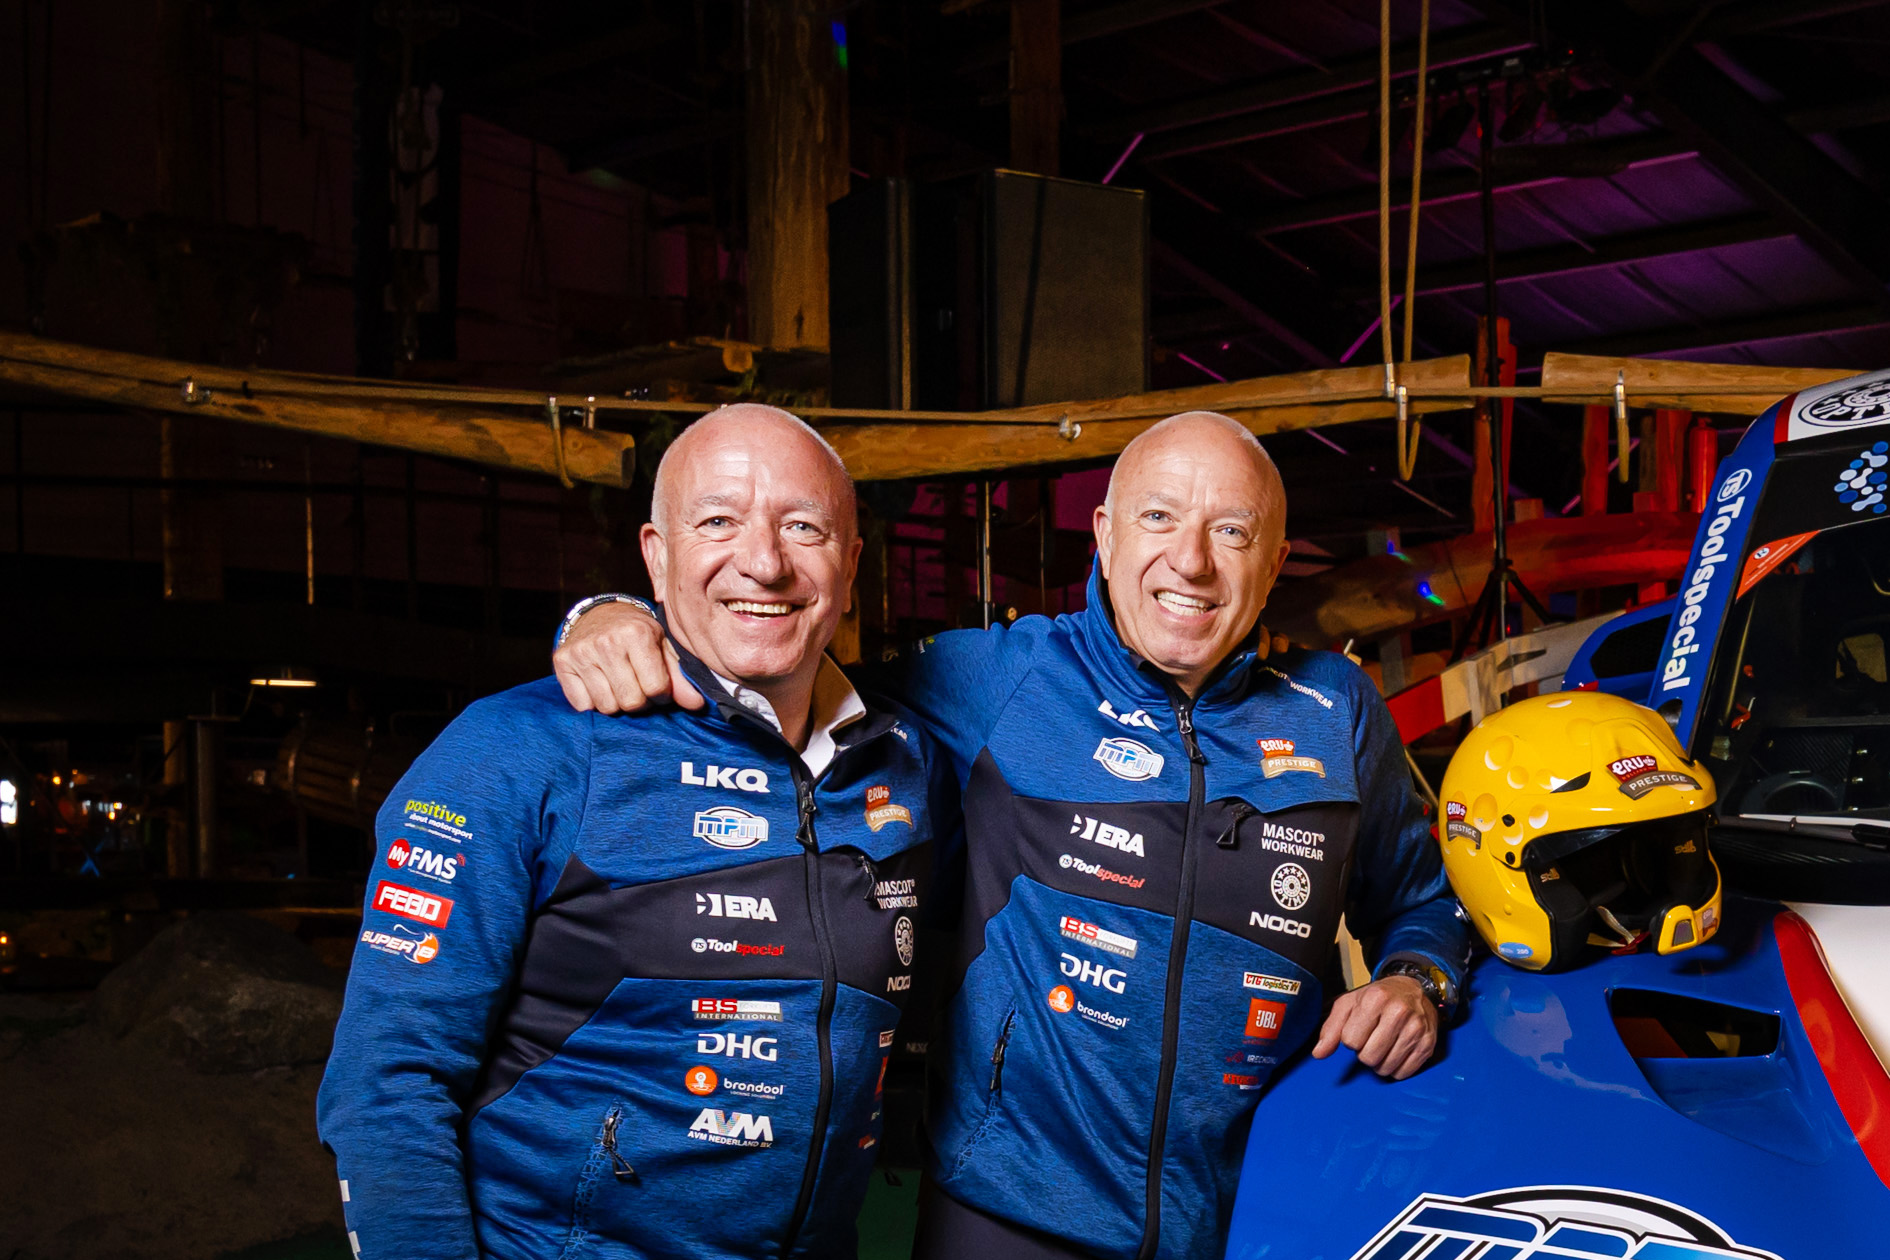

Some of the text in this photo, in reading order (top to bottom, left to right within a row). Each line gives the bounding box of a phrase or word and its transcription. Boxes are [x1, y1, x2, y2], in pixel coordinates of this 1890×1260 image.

[1662, 496, 1746, 692] Toolspecial
[1267, 758, 1317, 768] PRESTIGE
[681, 761, 771, 793] LKQ
[1628, 774, 1688, 791] PRESTIGE
[404, 800, 467, 827] positive
[428, 818, 473, 840] motorsport
[1095, 822, 1145, 858] ERA
[1261, 838, 1324, 861] WORKWEAR
[1072, 857, 1146, 889] Toolspecial
[724, 894, 778, 922] ERA
[1249, 911, 1312, 938] NOCO
[361, 930, 415, 954] SUPER
[707, 939, 784, 956] Toolspecial
[1061, 930, 1131, 957] INTERNATIONAL
[1060, 952, 1127, 995] DHG
[695, 1013, 779, 1022] INTERNATIONAL
[1255, 1010, 1277, 1030] JBL
[698, 1032, 778, 1062] DHG
[689, 1108, 774, 1141] AVM
[687, 1130, 707, 1141] AVM
[708, 1132, 759, 1148] NEDERLAND
